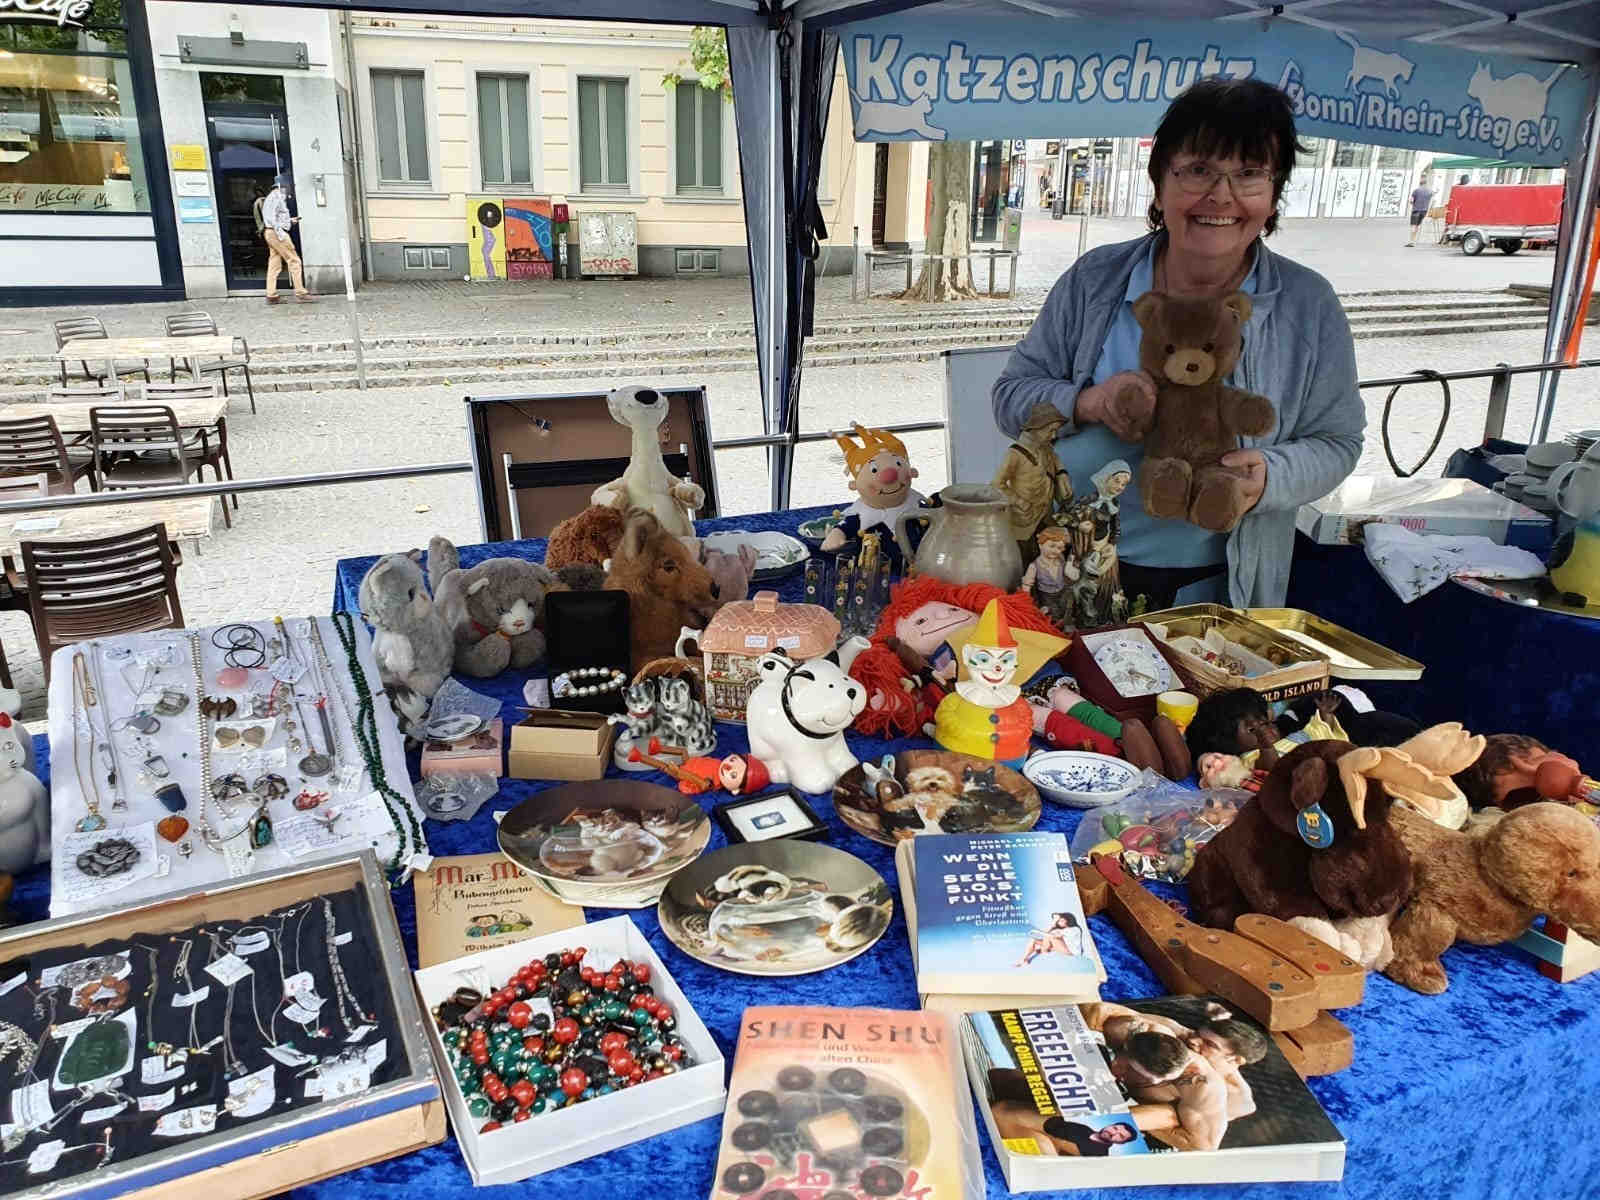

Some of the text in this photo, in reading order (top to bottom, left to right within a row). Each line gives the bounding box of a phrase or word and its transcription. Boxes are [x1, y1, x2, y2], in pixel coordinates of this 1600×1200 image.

[1284, 681, 1320, 699] ISLAND
[943, 852, 1011, 864] WENN
[977, 862, 1014, 871] DIE
[943, 871, 1017, 883] SEELE
[946, 881, 1021, 894] S.O.S.
[948, 892, 1024, 905] FUNKT
[746, 1021, 943, 1045] SHEN SHU
[1021, 1010, 1097, 1112] FREEFIGHT
[1025, 1074, 1057, 1116] REGELN
